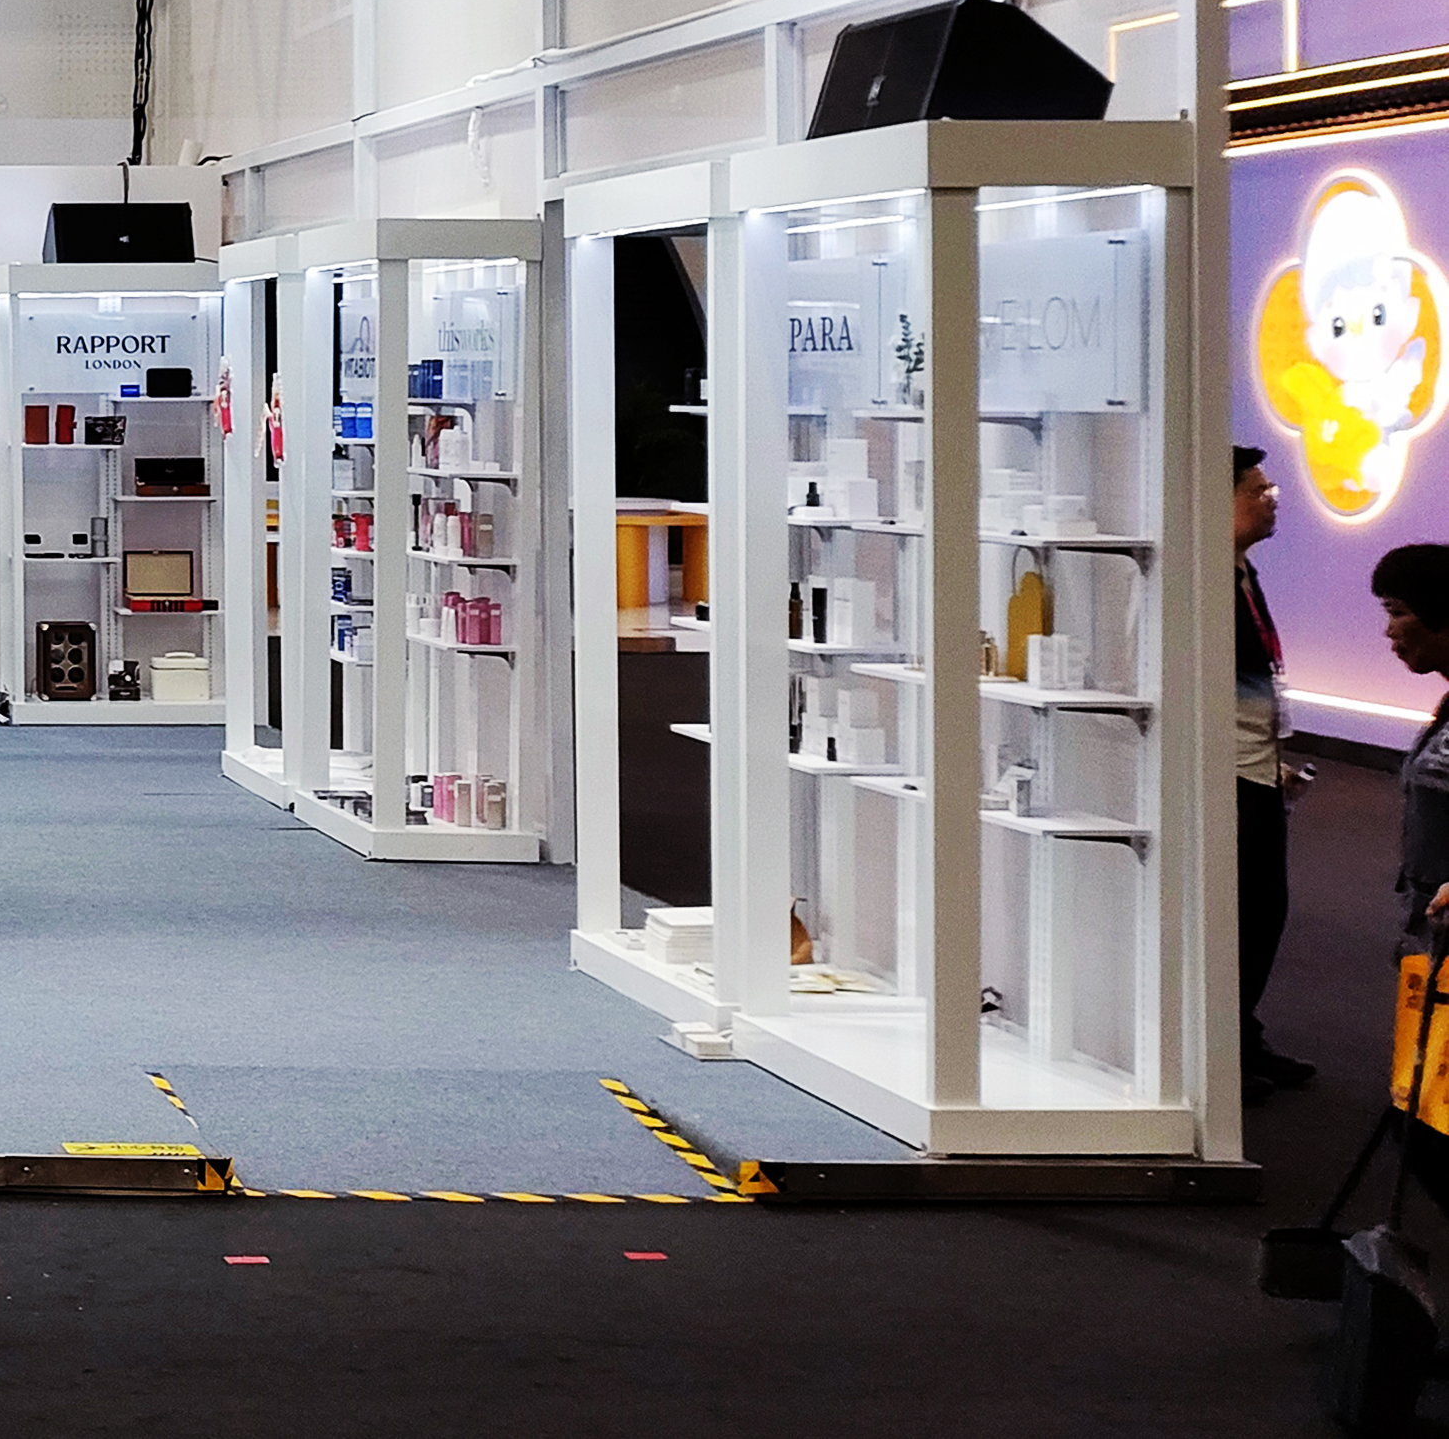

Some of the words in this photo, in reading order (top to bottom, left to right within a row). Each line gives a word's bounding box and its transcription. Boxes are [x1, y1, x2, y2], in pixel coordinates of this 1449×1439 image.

[788, 315, 854, 352] PARA
[56, 335, 171, 354] RAPPORT
[85, 359, 141, 369] LONDON
